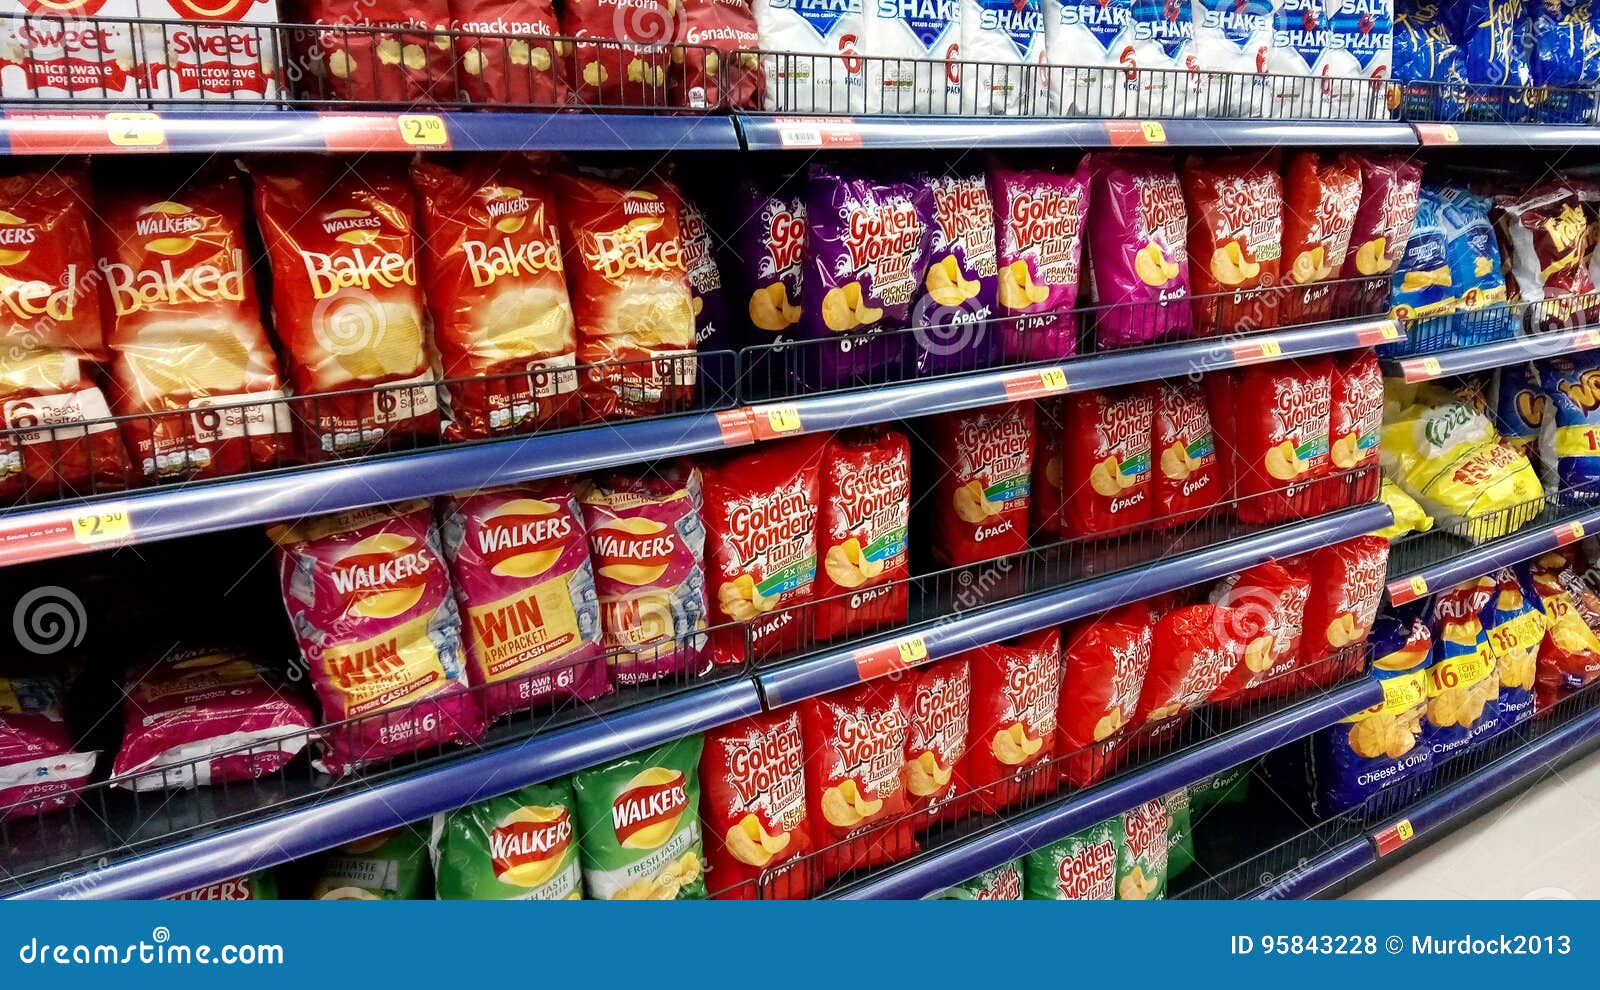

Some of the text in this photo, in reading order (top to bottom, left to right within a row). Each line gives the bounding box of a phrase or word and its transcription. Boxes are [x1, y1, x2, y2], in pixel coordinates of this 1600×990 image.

[876, 0, 962, 20] SHAKE
[462, 17, 509, 35] snack
[687, 26, 737, 44] 6 snack
[173, 31, 260, 57] Sweet
[838, 34, 865, 75] 6
[1329, 33, 1391, 50] SHAKE
[29, 63, 113, 76] microwave
[181, 67, 256, 79] microwave
[945, 43, 961, 84] 6
[47, 75, 99, 86] popcorn
[486, 198, 530, 218] WALKERS
[623, 200, 666, 216] WALKERS
[933, 185, 990, 218] Golden
[1013, 191, 1079, 228] Golden
[1141, 180, 1183, 211] Golden
[136, 216, 203, 236] WALKERS
[323, 215, 382, 235] WALKERS
[850, 208, 920, 244] Golden
[937, 207, 994, 244] Wonder
[1143, 200, 1186, 234] Wonder
[1222, 201, 1282, 235] Wonder
[1012, 217, 1078, 250] Wonder
[1040, 238, 1072, 257] fully
[462, 224, 564, 288] Baked
[847, 231, 920, 272] Wonder
[874, 255, 910, 276] fully
[104, 248, 246, 317] Baked
[1045, 265, 1074, 277] PRAWN
[882, 281, 917, 299] PICKLED
[962, 305, 992, 324] PACK
[1278, 384, 1330, 413] Golden
[199, 401, 221, 431] 6
[225, 413, 265, 426] Salted
[1279, 400, 1331, 433] Wonder
[964, 418, 1025, 450] Golden
[1101, 415, 1152, 450] Wonde
[1125, 433, 1151, 452] fully
[965, 436, 1028, 474] Wonder
[991, 456, 1023, 476] fully
[840, 462, 907, 502] Golden
[1182, 474, 1210, 496] 6 PACK
[730, 491, 807, 541] Golden
[838, 481, 908, 531] Wonder
[1110, 491, 1145, 514] 6 PACK
[871, 504, 901, 531] fully
[974, 519, 1013, 542] 6 PACK
[478, 515, 572, 554] WALKERS
[591, 533, 676, 560] WALKERS
[728, 513, 811, 566] Wonder
[765, 537, 805, 566] fully
[766, 552, 804, 575] flavoured
[331, 549, 432, 594] WALKERS
[851, 594, 862, 609] 6
[473, 595, 545, 648] WIN
[328, 638, 405, 688] WIN
[492, 645, 509, 661] PAY
[499, 645, 546, 671] THERE CASH
[1275, 657, 1296, 675] PACK
[557, 670, 569, 688] 6
[1009, 651, 1060, 694] Golden
[1432, 663, 1459, 691] 16
[380, 686, 409, 704] CASH
[916, 677, 970, 722] Golden
[422, 713, 437, 731] 6
[838, 708, 908, 748] Golden
[730, 729, 802, 779] Golden
[1433, 737, 1470, 754] Cheese
[870, 751, 899, 773] fully
[1357, 760, 1405, 786] Cheese &
[731, 753, 803, 807] Wonde
[769, 774, 801, 804] fully
[1212, 769, 1241, 790] 6 PACK
[612, 782, 687, 829] WALKERS
[490, 814, 572, 859] WALKERS
[1169, 833, 1184, 849] ACK
[627, 834, 685, 877] FRESH TASTE
[1059, 840, 1116, 884] Golden
